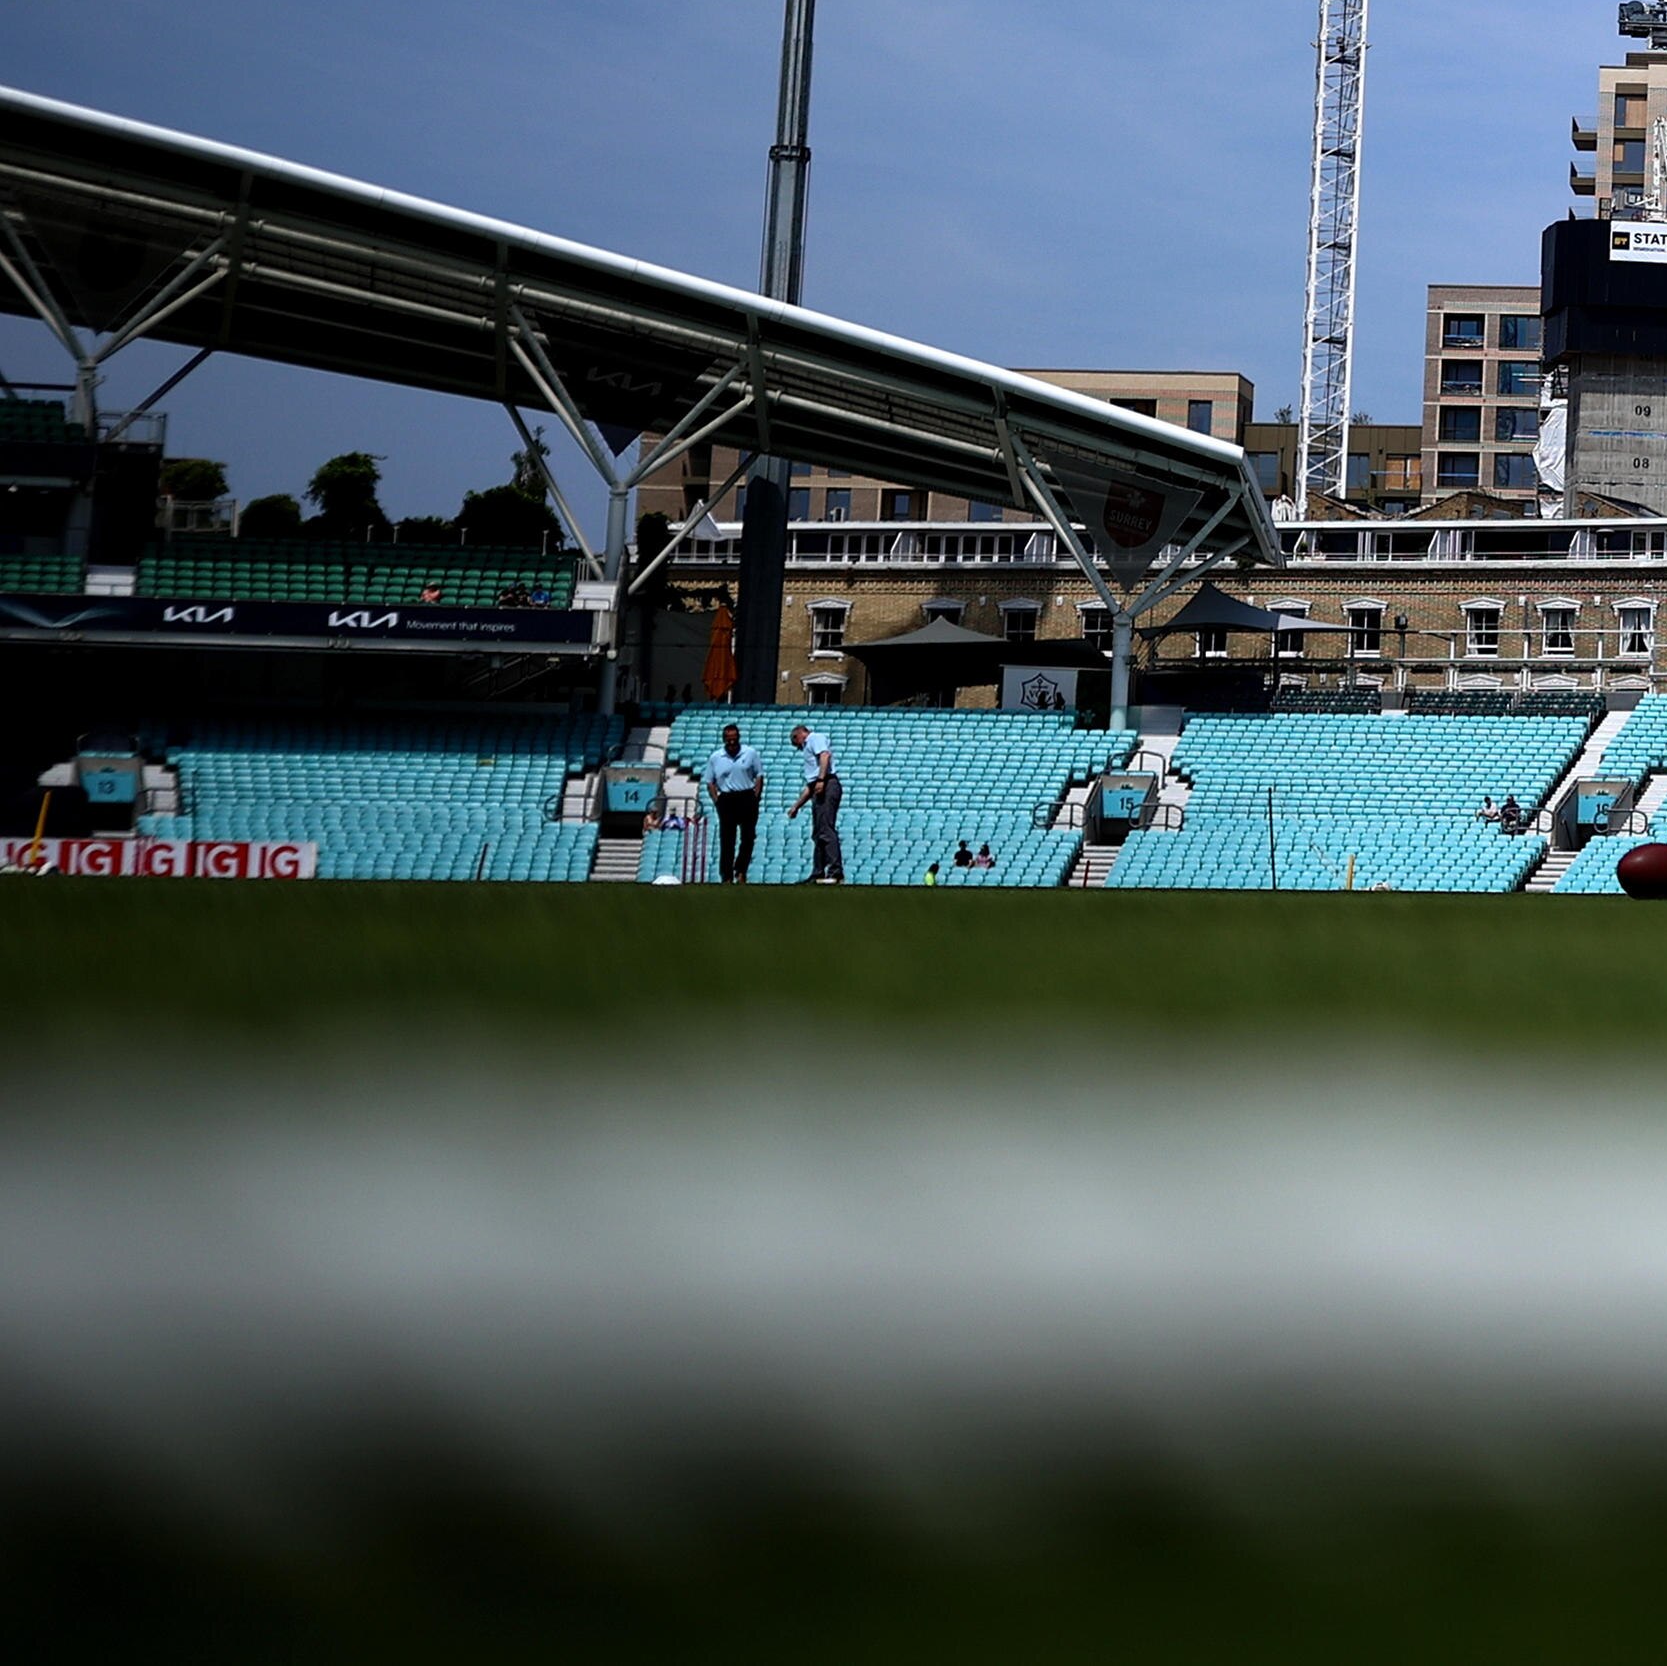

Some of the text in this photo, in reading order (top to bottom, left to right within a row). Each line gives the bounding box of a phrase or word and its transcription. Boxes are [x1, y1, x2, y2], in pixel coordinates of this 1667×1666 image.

[1635, 405, 1651, 417] 09
[1633, 457, 1649, 469] 08
[1110, 509, 1153, 531] SURREY
[406, 620, 515, 632] Movement that inspires
[624, 790, 640, 804] 14
[1120, 797, 1135, 810] 15
[70, 842, 113, 876] IG
[196, 844, 239, 877] IG
[259, 845, 299, 878] IG
